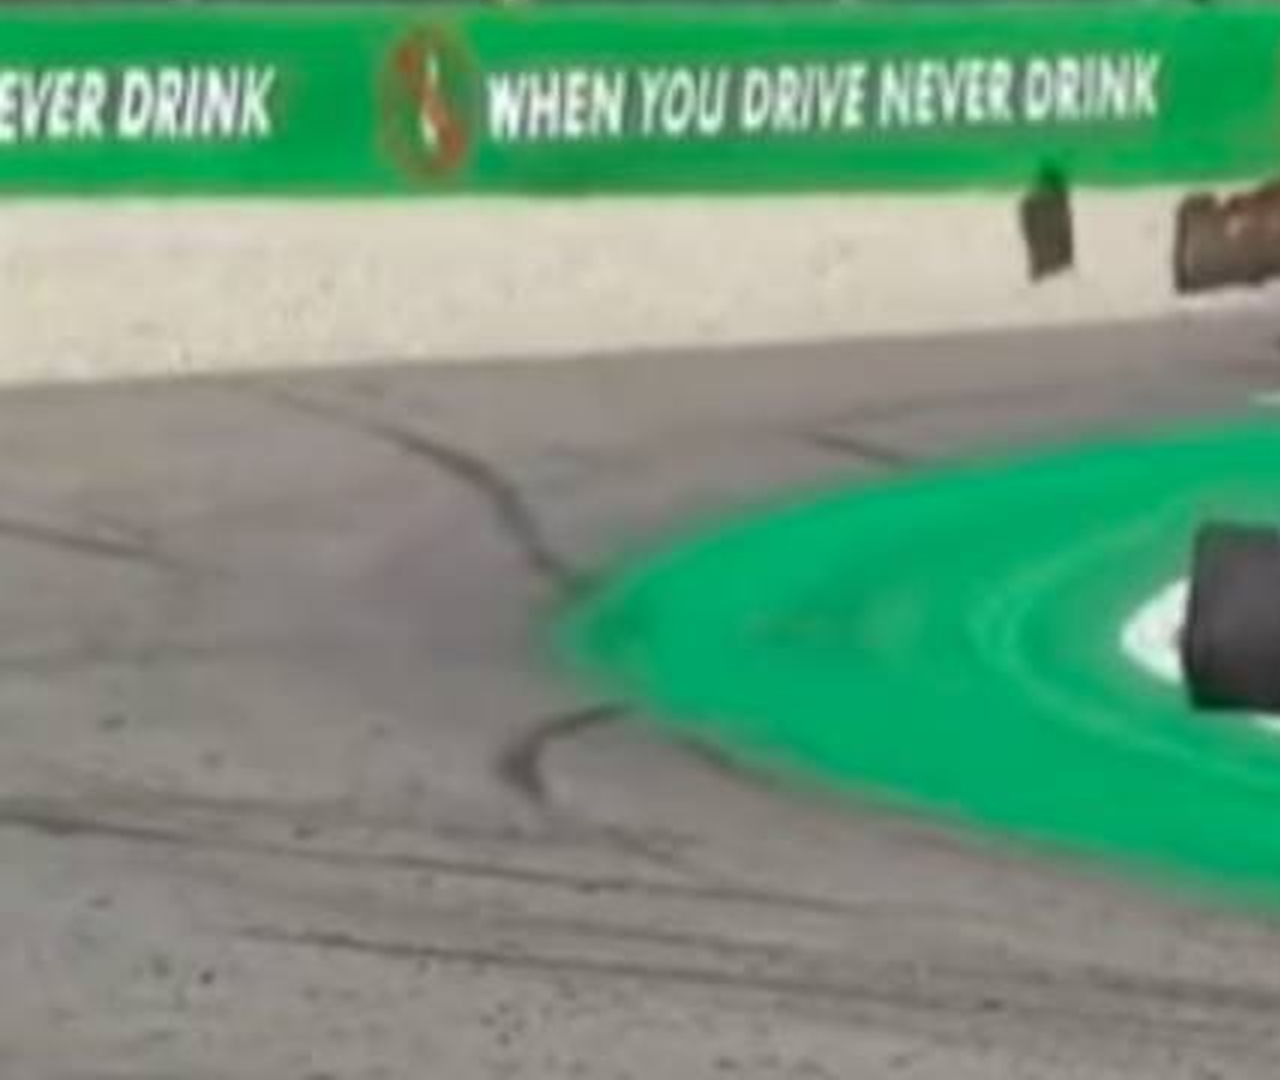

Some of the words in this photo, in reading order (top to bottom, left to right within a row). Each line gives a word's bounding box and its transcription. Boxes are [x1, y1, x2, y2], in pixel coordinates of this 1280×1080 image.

[119, 65, 275, 138] DRINK
[487, 69, 627, 142] WHEN
[639, 65, 728, 135] YOU
[740, 62, 866, 131] DRIVE
[879, 58, 1013, 127] NEVER
[1024, 54, 1160, 120] DRINK
